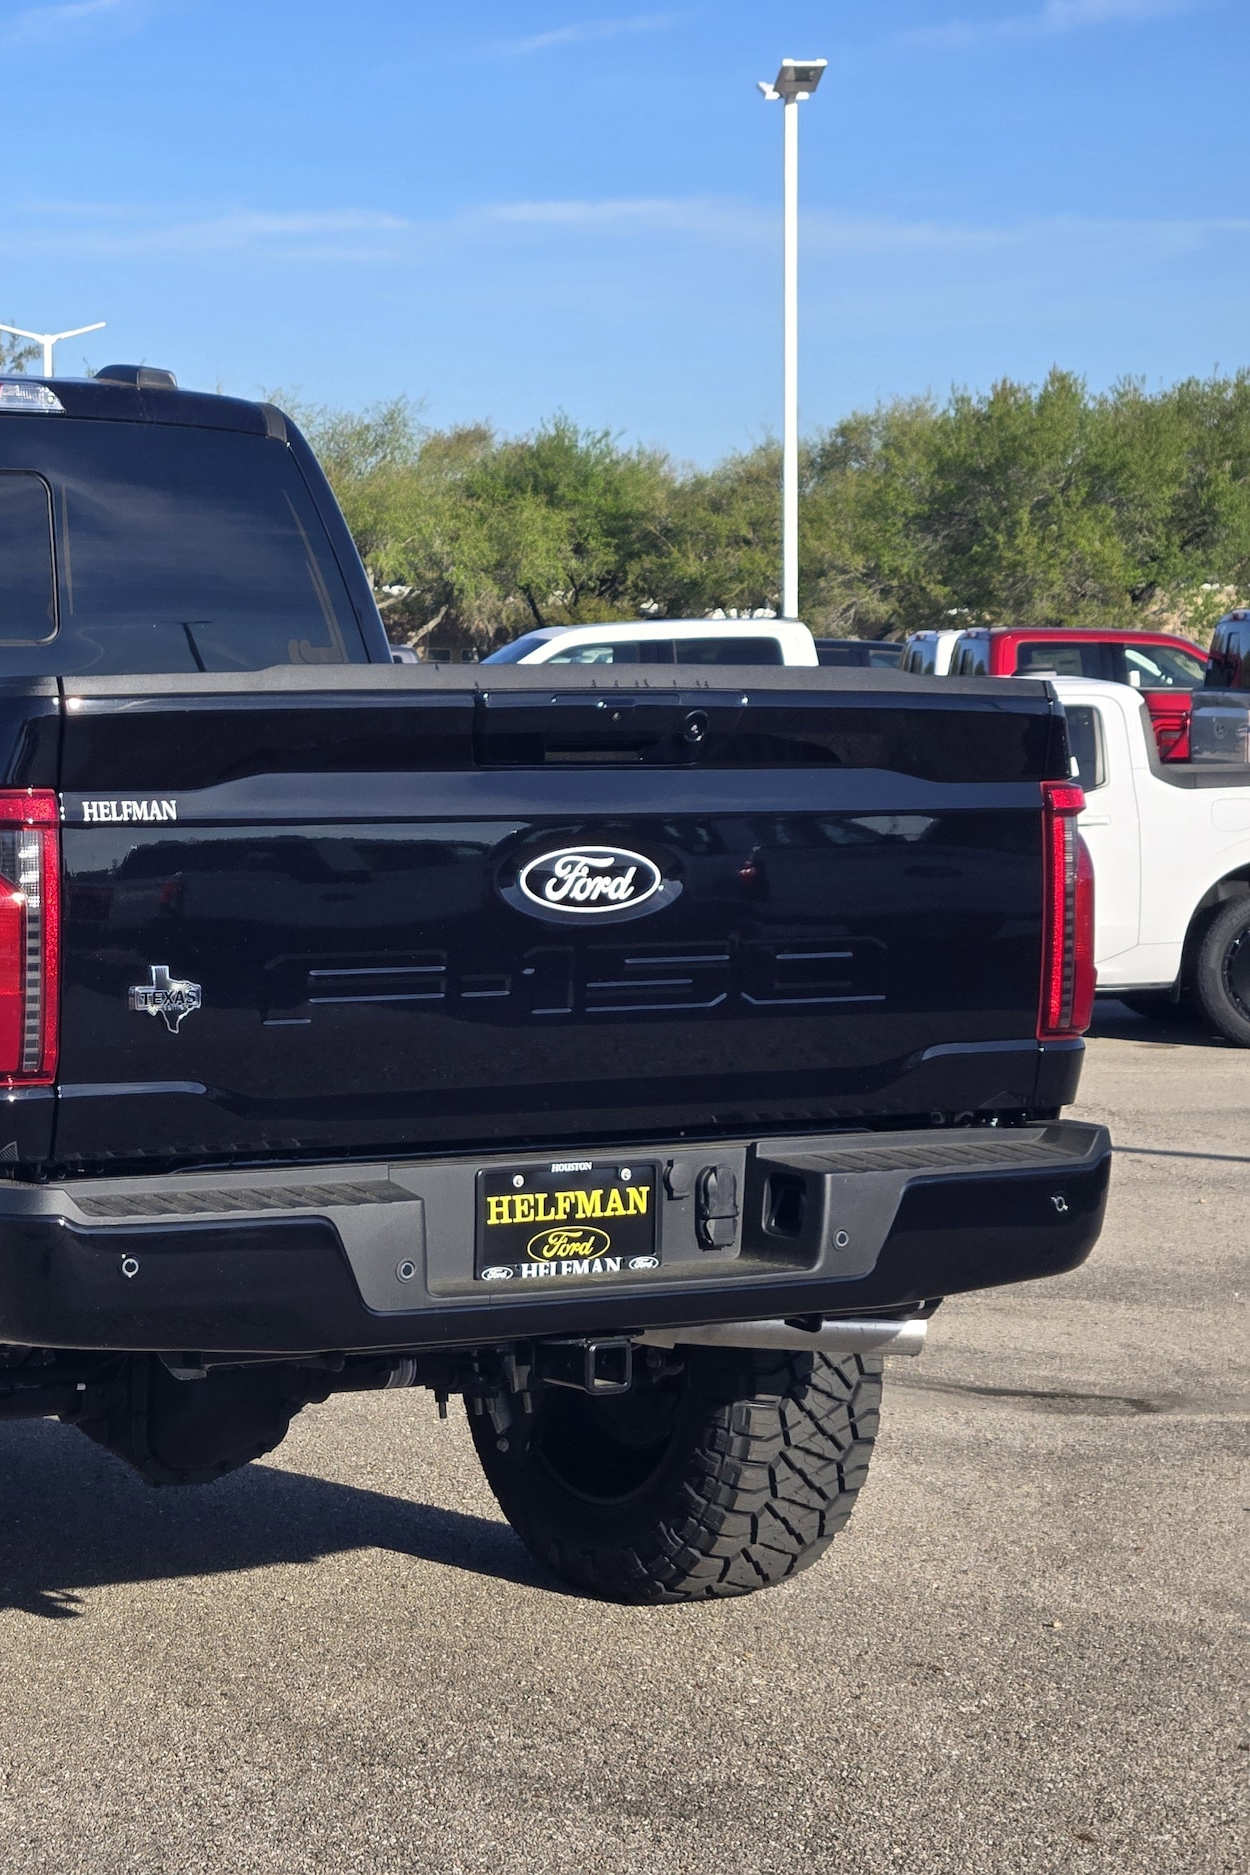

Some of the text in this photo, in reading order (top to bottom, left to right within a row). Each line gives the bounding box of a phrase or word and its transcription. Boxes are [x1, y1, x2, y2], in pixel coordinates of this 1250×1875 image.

[82, 800, 178, 822] HELFMAN
[545, 855, 638, 901] Ford
[140, 989, 197, 1006] TEXAS
[551, 1162, 592, 1172] HOUSTON
[486, 1186, 650, 1225] HELFMAN
[543, 1230, 595, 1257] Ford
